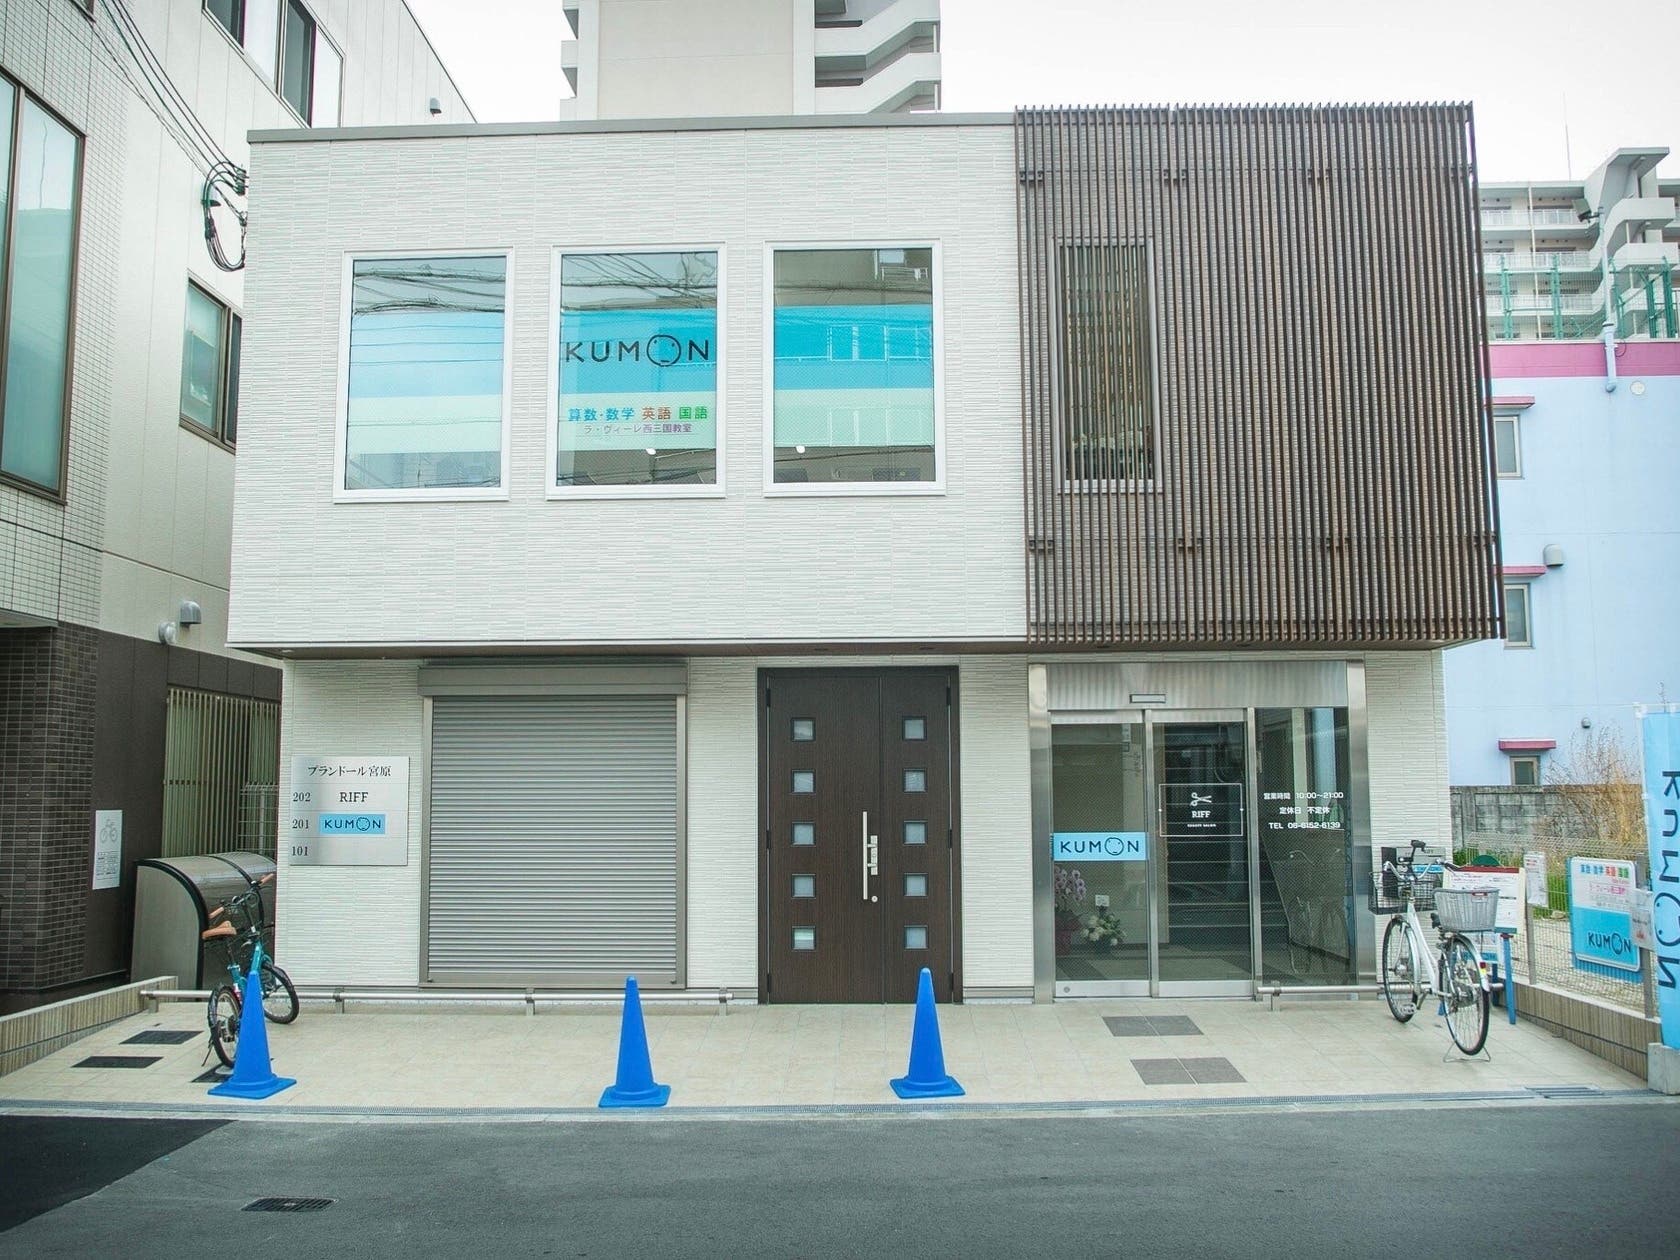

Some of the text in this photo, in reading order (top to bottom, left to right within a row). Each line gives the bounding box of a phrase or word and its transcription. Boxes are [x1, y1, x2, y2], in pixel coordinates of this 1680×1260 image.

[565, 334, 709, 367] KUMON
[641, 406, 671, 421] 英語
[678, 406, 708, 420] 国語
[293, 792, 369, 802] 202 RIFF
[1192, 810, 1211, 818] RIFF
[1279, 806, 1301, 814] 定休日
[292, 817, 381, 831] 201 KUMON
[292, 846, 308, 856] 101
[1060, 837, 1140, 856] KUMON
[1588, 932, 1631, 955] KUMON
